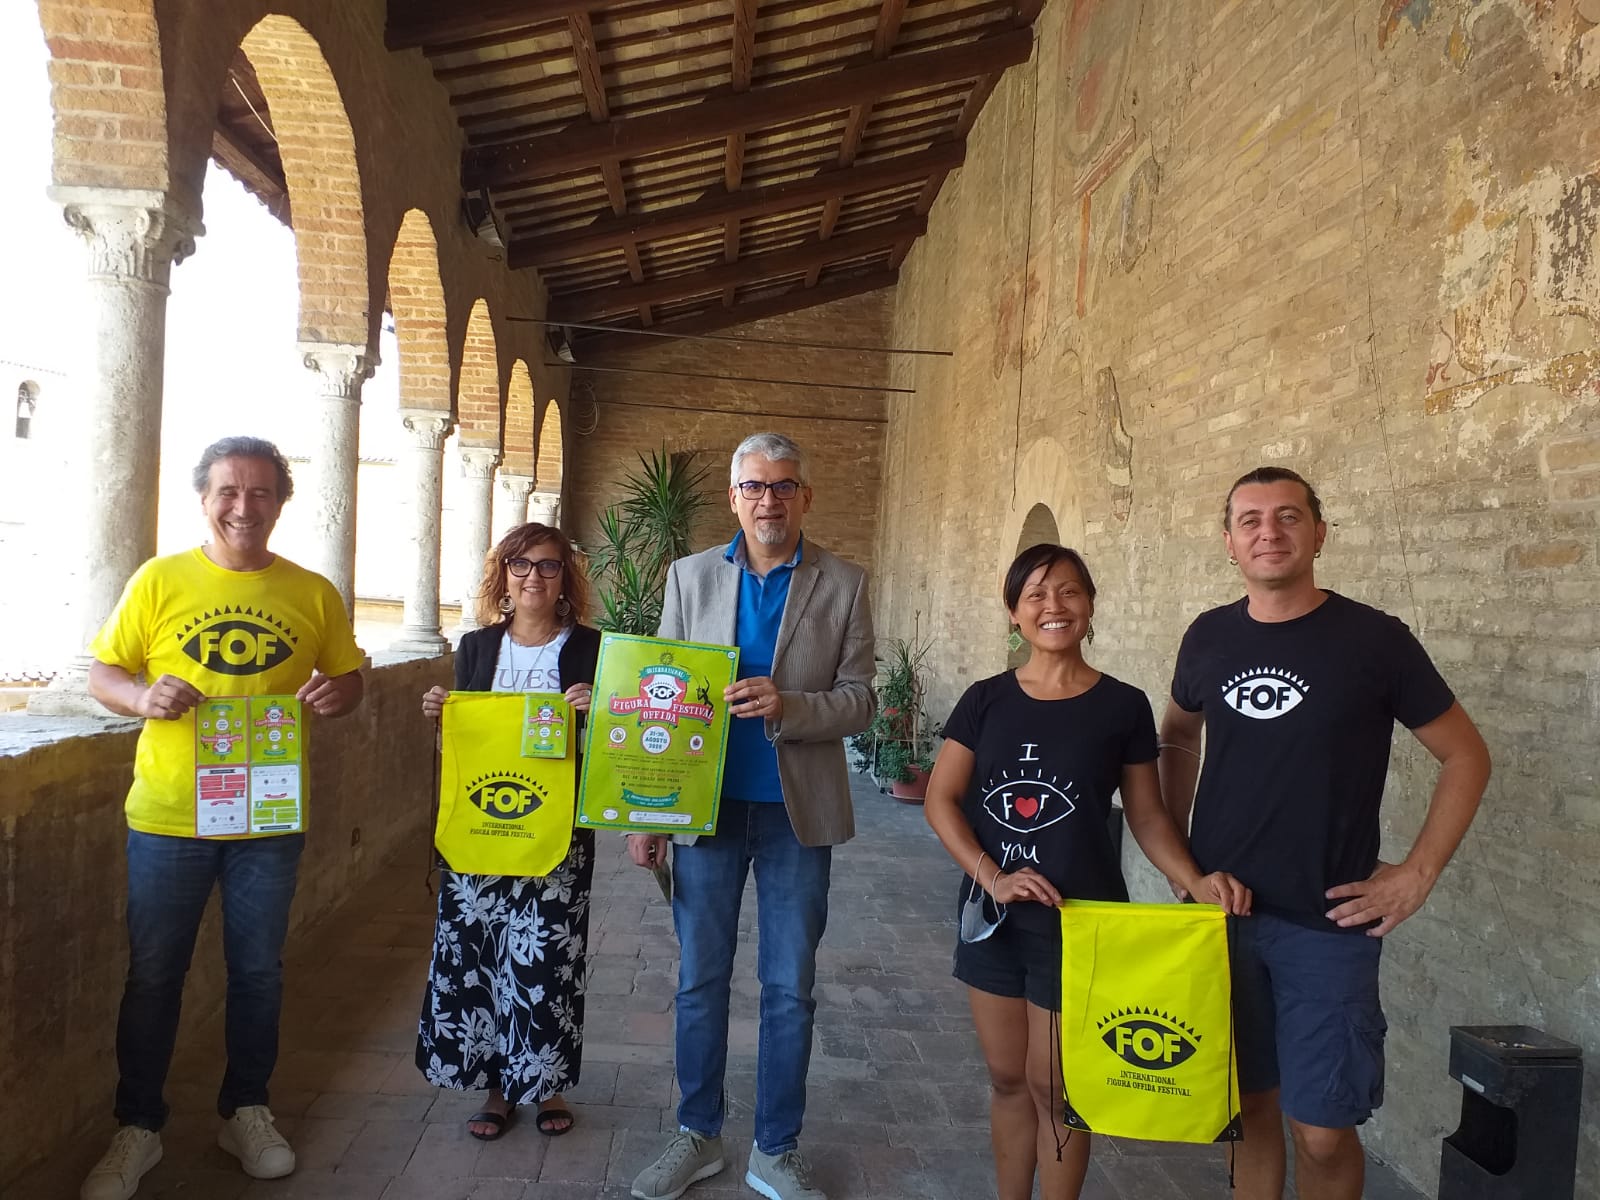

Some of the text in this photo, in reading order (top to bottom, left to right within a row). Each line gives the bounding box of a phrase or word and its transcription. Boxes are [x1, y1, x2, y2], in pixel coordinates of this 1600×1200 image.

[200, 628, 277, 666] FOF
[653, 688, 672, 699] FOF
[1236, 684, 1291, 710] FOF
[613, 699, 713, 720] FIGURA FESTIVAL
[643, 711, 676, 723] OFFIDA
[1018, 743, 1040, 761] I
[481, 786, 532, 813] FOF
[1115, 1026, 1181, 1063] FOF
[1107, 1078, 1192, 1097] FIGURA OFFIDA FESTIVAL
[1120, 1070, 1176, 1085] INTERNATIONAL
